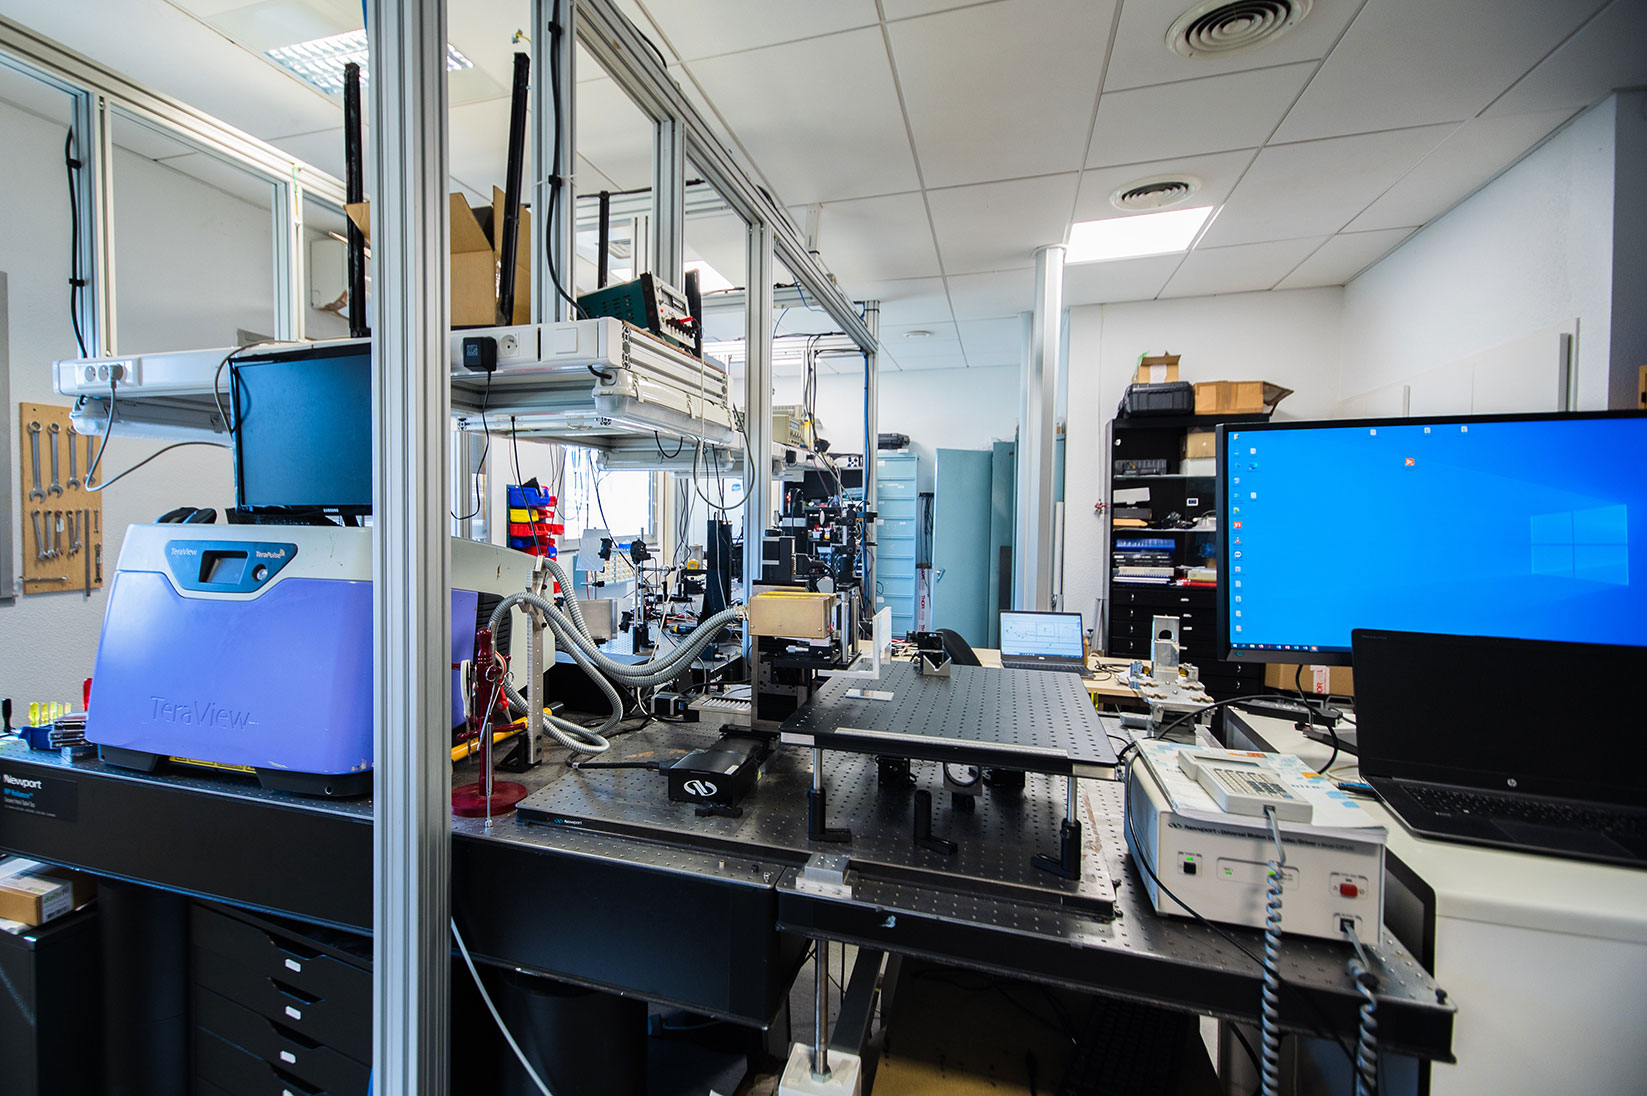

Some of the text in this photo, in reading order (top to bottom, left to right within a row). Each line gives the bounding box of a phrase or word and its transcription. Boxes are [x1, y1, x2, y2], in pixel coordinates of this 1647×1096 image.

[171, 547, 198, 556] TeraView
[256, 550, 281, 559] TeraPulse
[150, 695, 251, 730] TeraView
[3, 774, 42, 789] Newport
[1184, 825, 1217, 834] Newport
